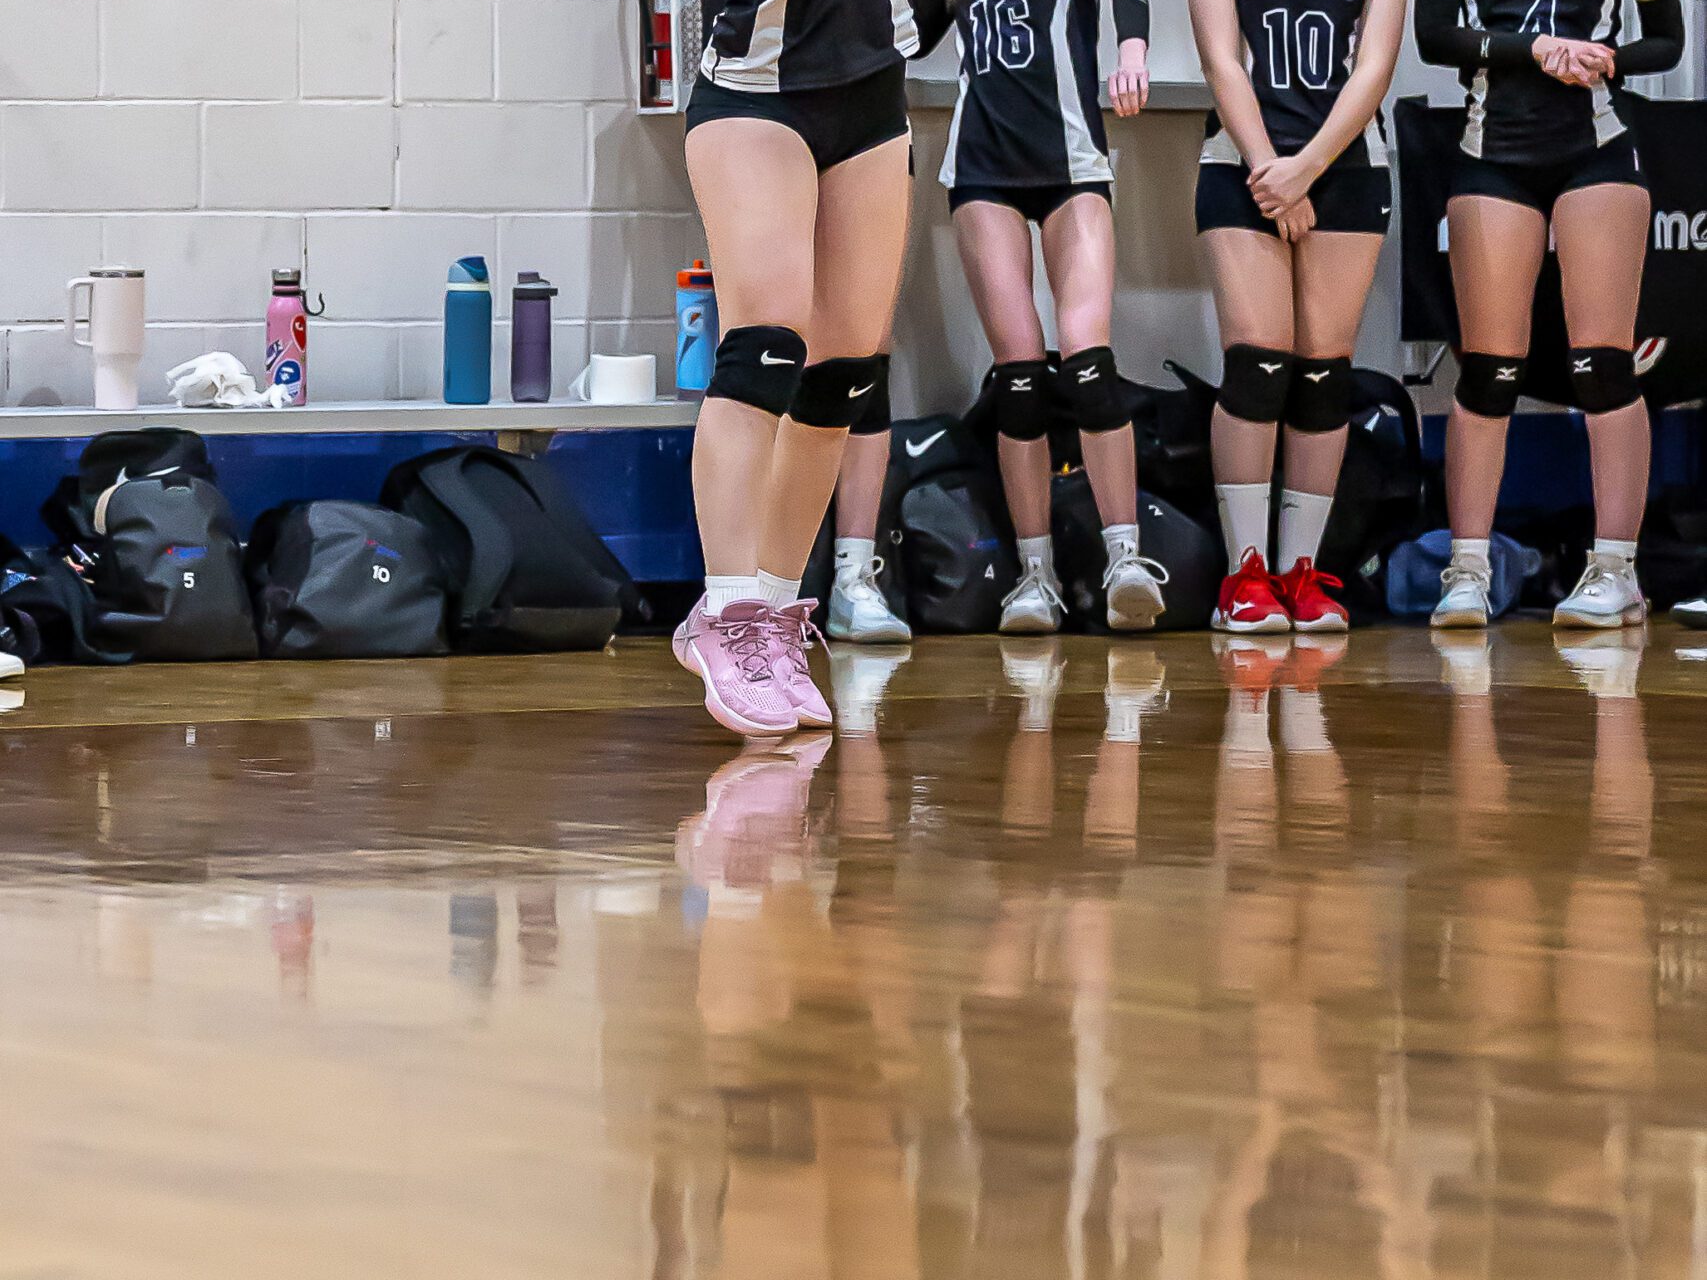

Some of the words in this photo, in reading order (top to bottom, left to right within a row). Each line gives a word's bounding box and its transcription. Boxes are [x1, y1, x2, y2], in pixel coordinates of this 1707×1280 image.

[1262, 7, 1335, 90] 10
[183, 572, 195, 589] 5
[372, 565, 391, 583] 10
